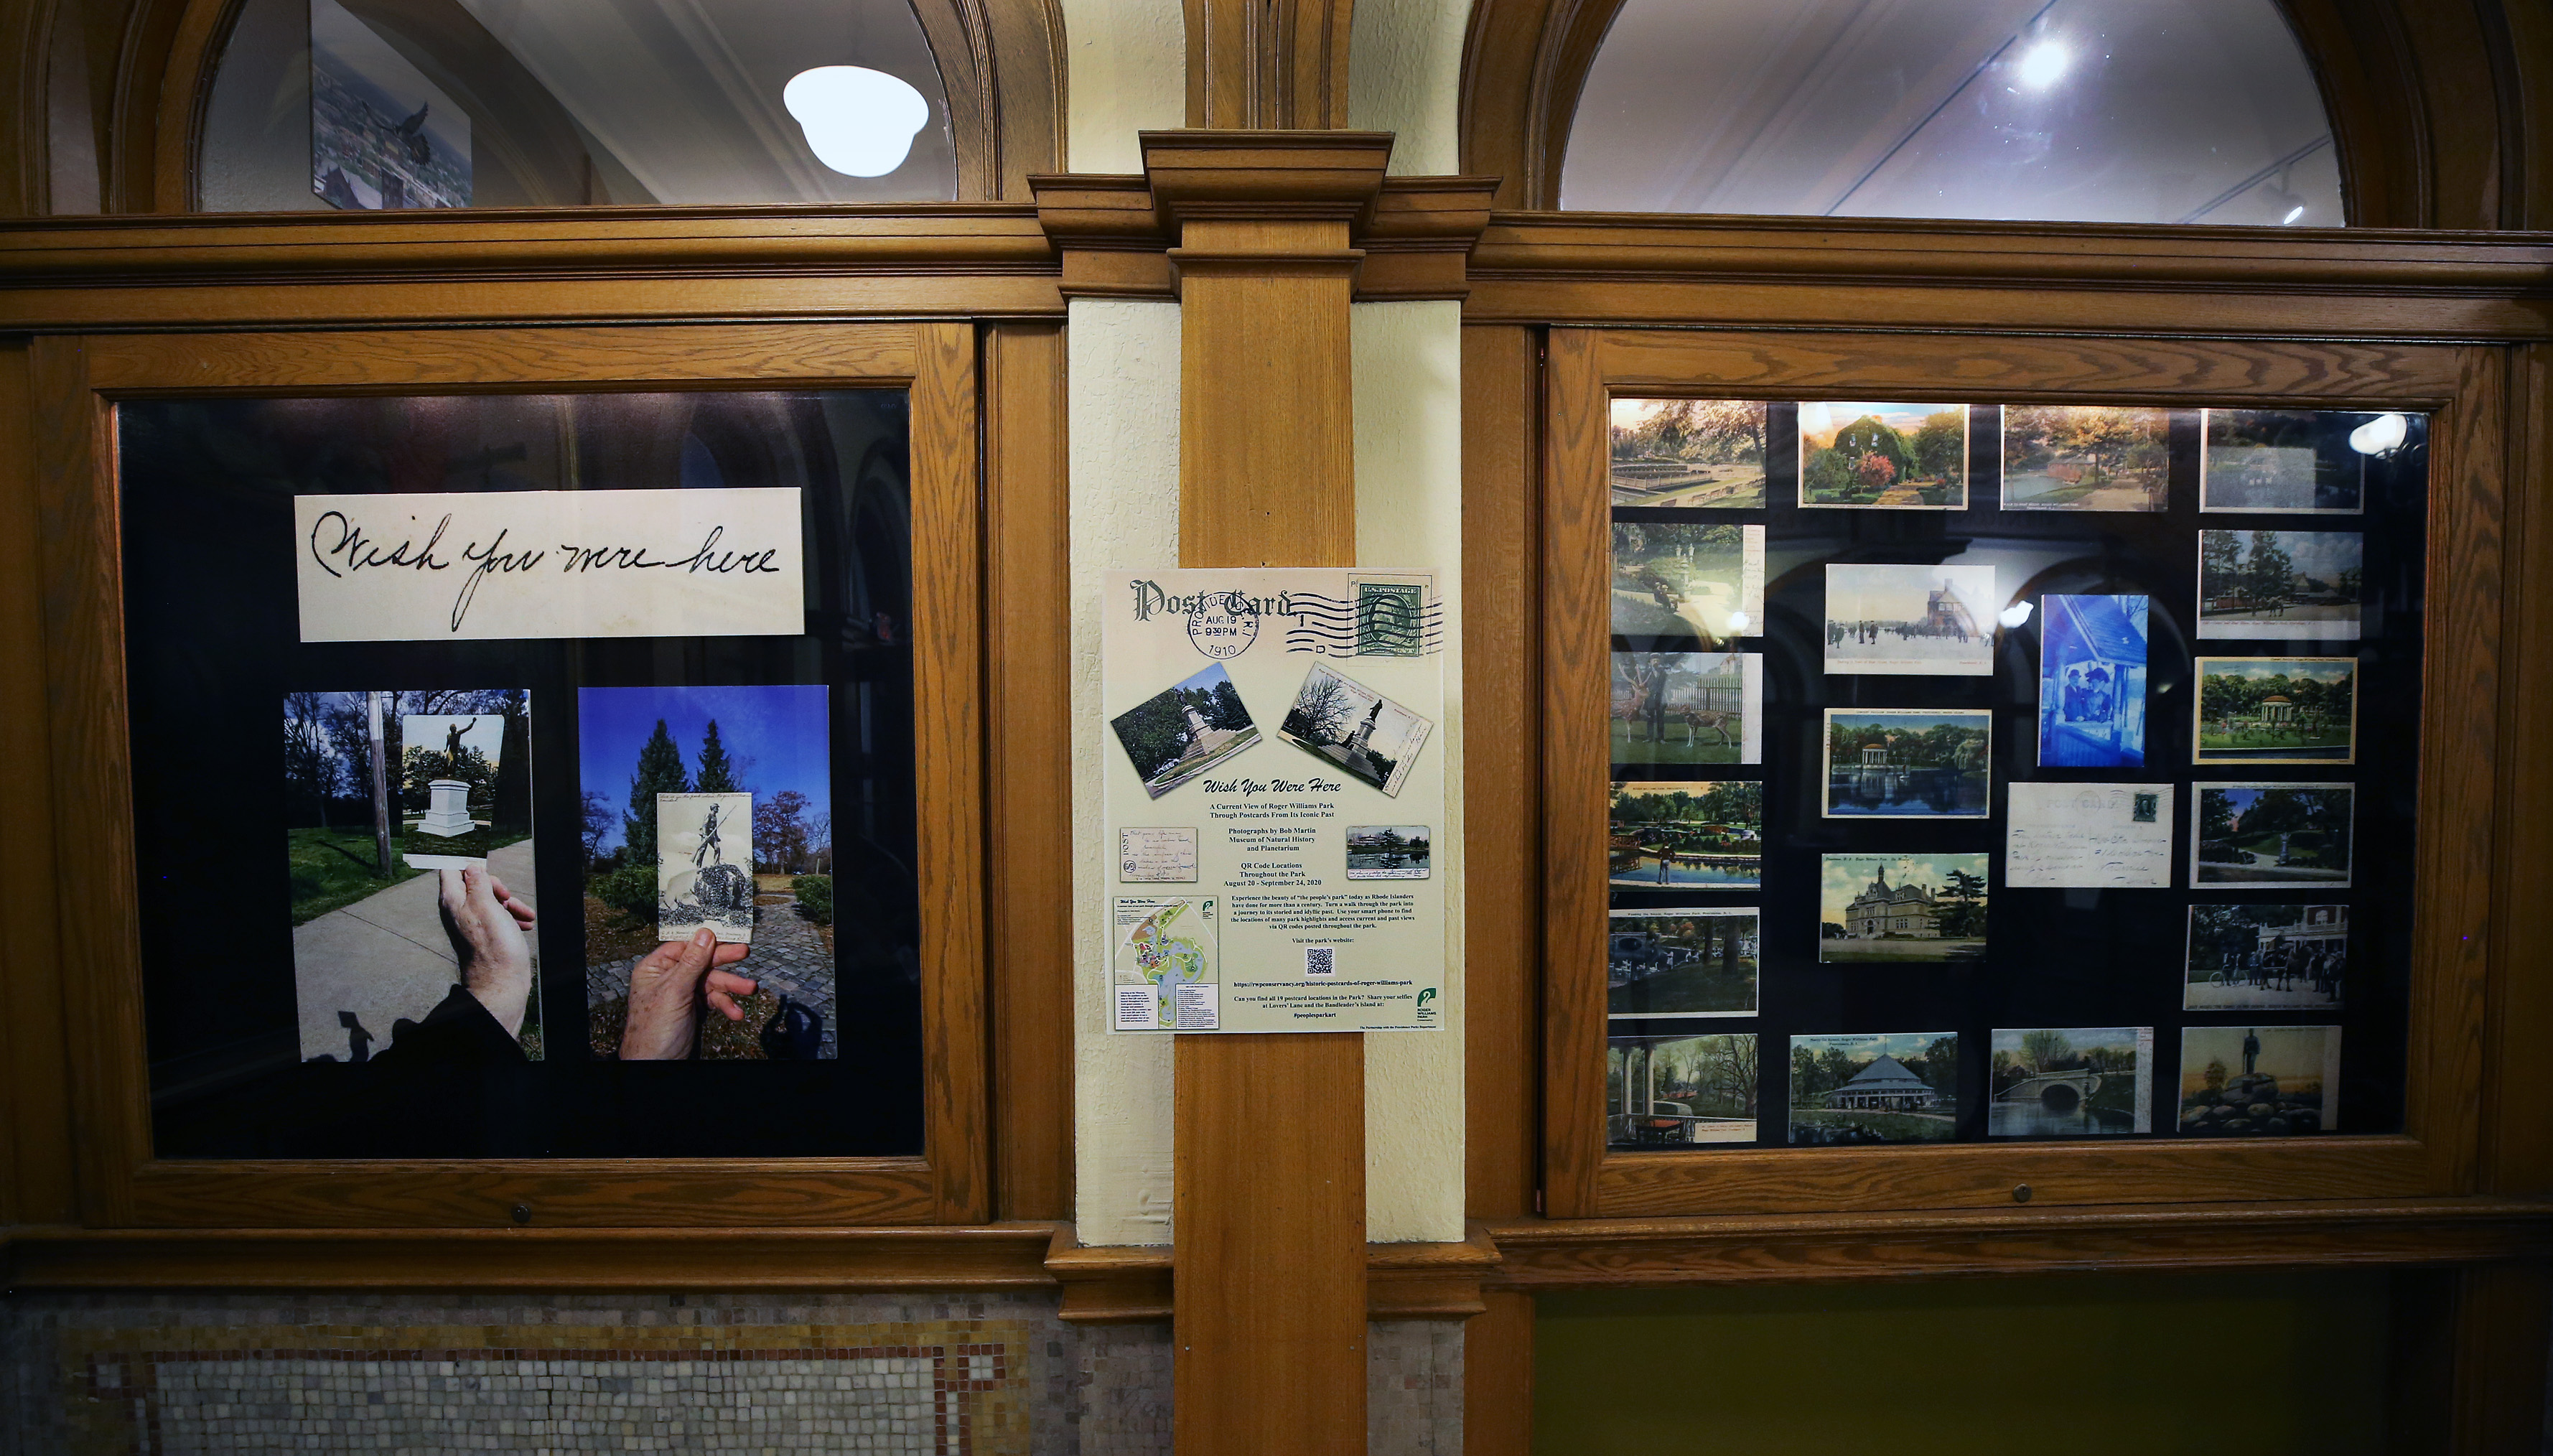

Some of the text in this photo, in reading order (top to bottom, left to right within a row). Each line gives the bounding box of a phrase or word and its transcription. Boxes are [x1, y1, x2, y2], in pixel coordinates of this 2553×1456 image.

[666, 525, 780, 574] here
[1129, 579, 1207, 622] Post
[1227, 615, 1237, 625] 19
[1208, 644, 1236, 656] 1910
[1203, 778, 1341, 797] Wish You Were Here
